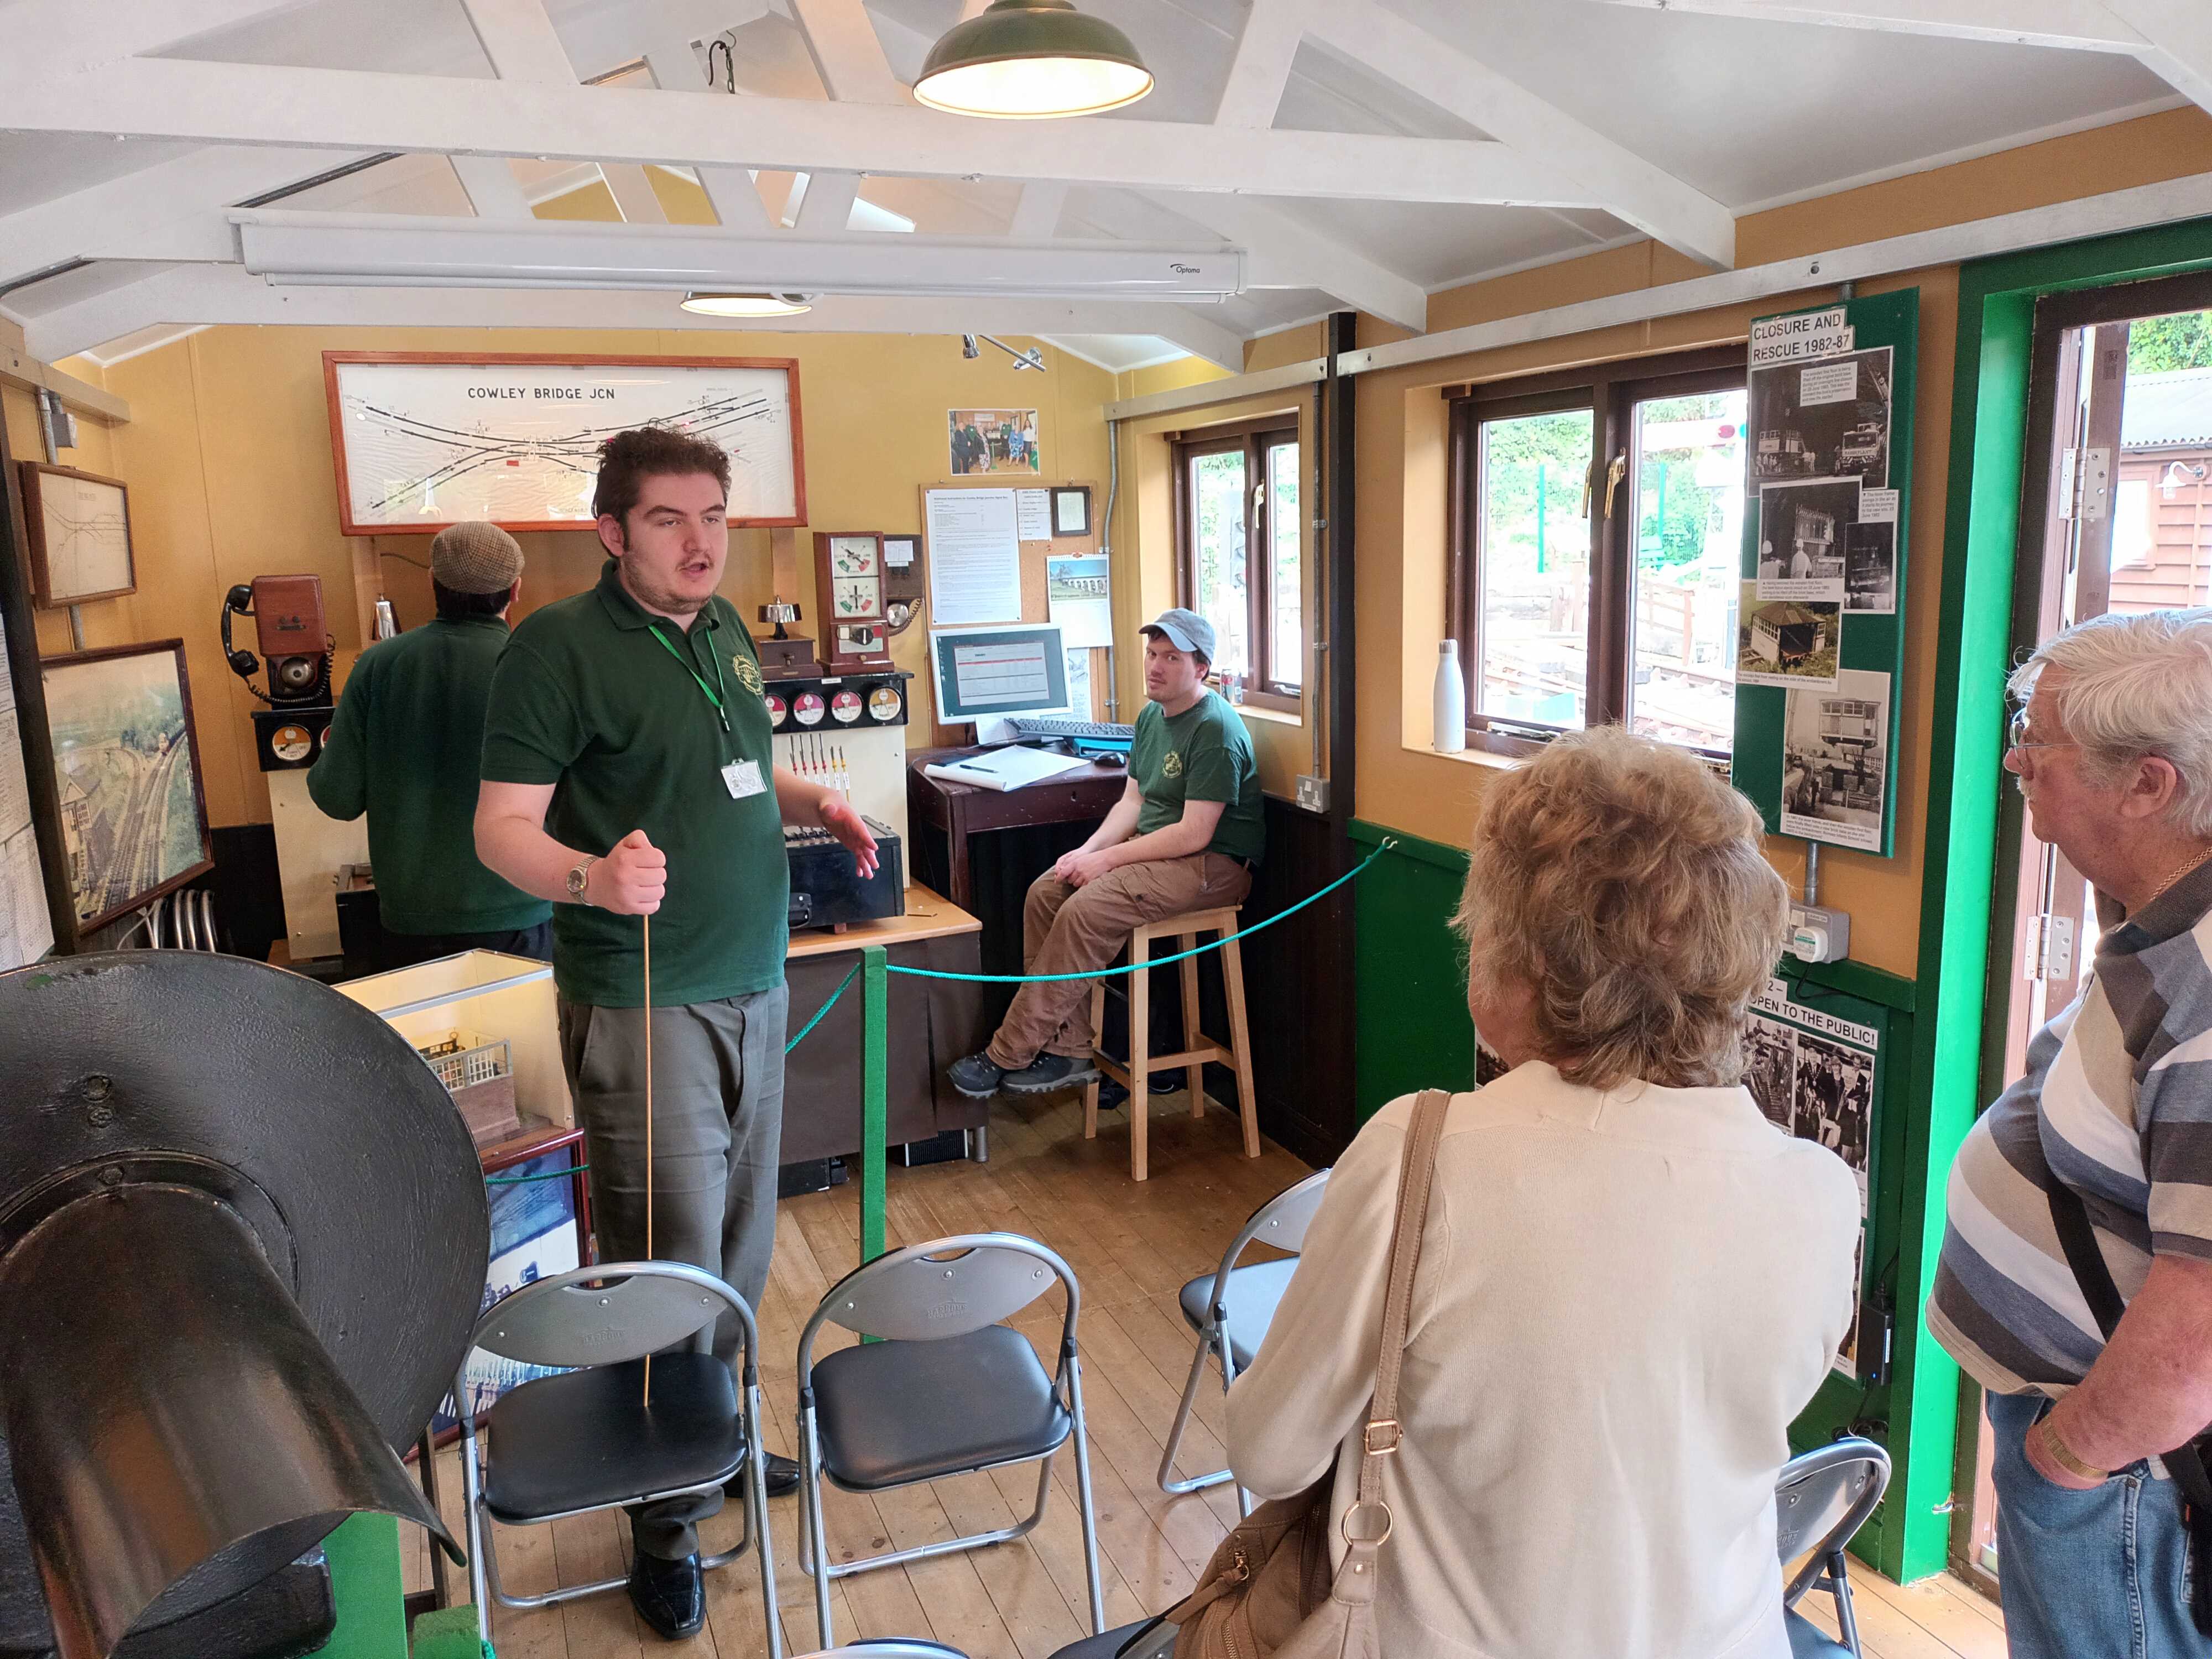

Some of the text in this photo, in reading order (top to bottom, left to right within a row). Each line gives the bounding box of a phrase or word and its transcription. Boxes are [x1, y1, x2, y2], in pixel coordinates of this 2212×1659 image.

[1176, 266, 1200, 274] Optoma
[1754, 314, 1841, 340] CLOSURE AND
[1753, 334, 1850, 361] RESCUE 1982-87
[468, 388, 615, 399] COWLEY BRIDGE JCN
[1783, 1003, 1797, 1018] TO
[1801, 1010, 1823, 1027] THE
[1827, 1019, 1875, 1045] PUBLIC!
